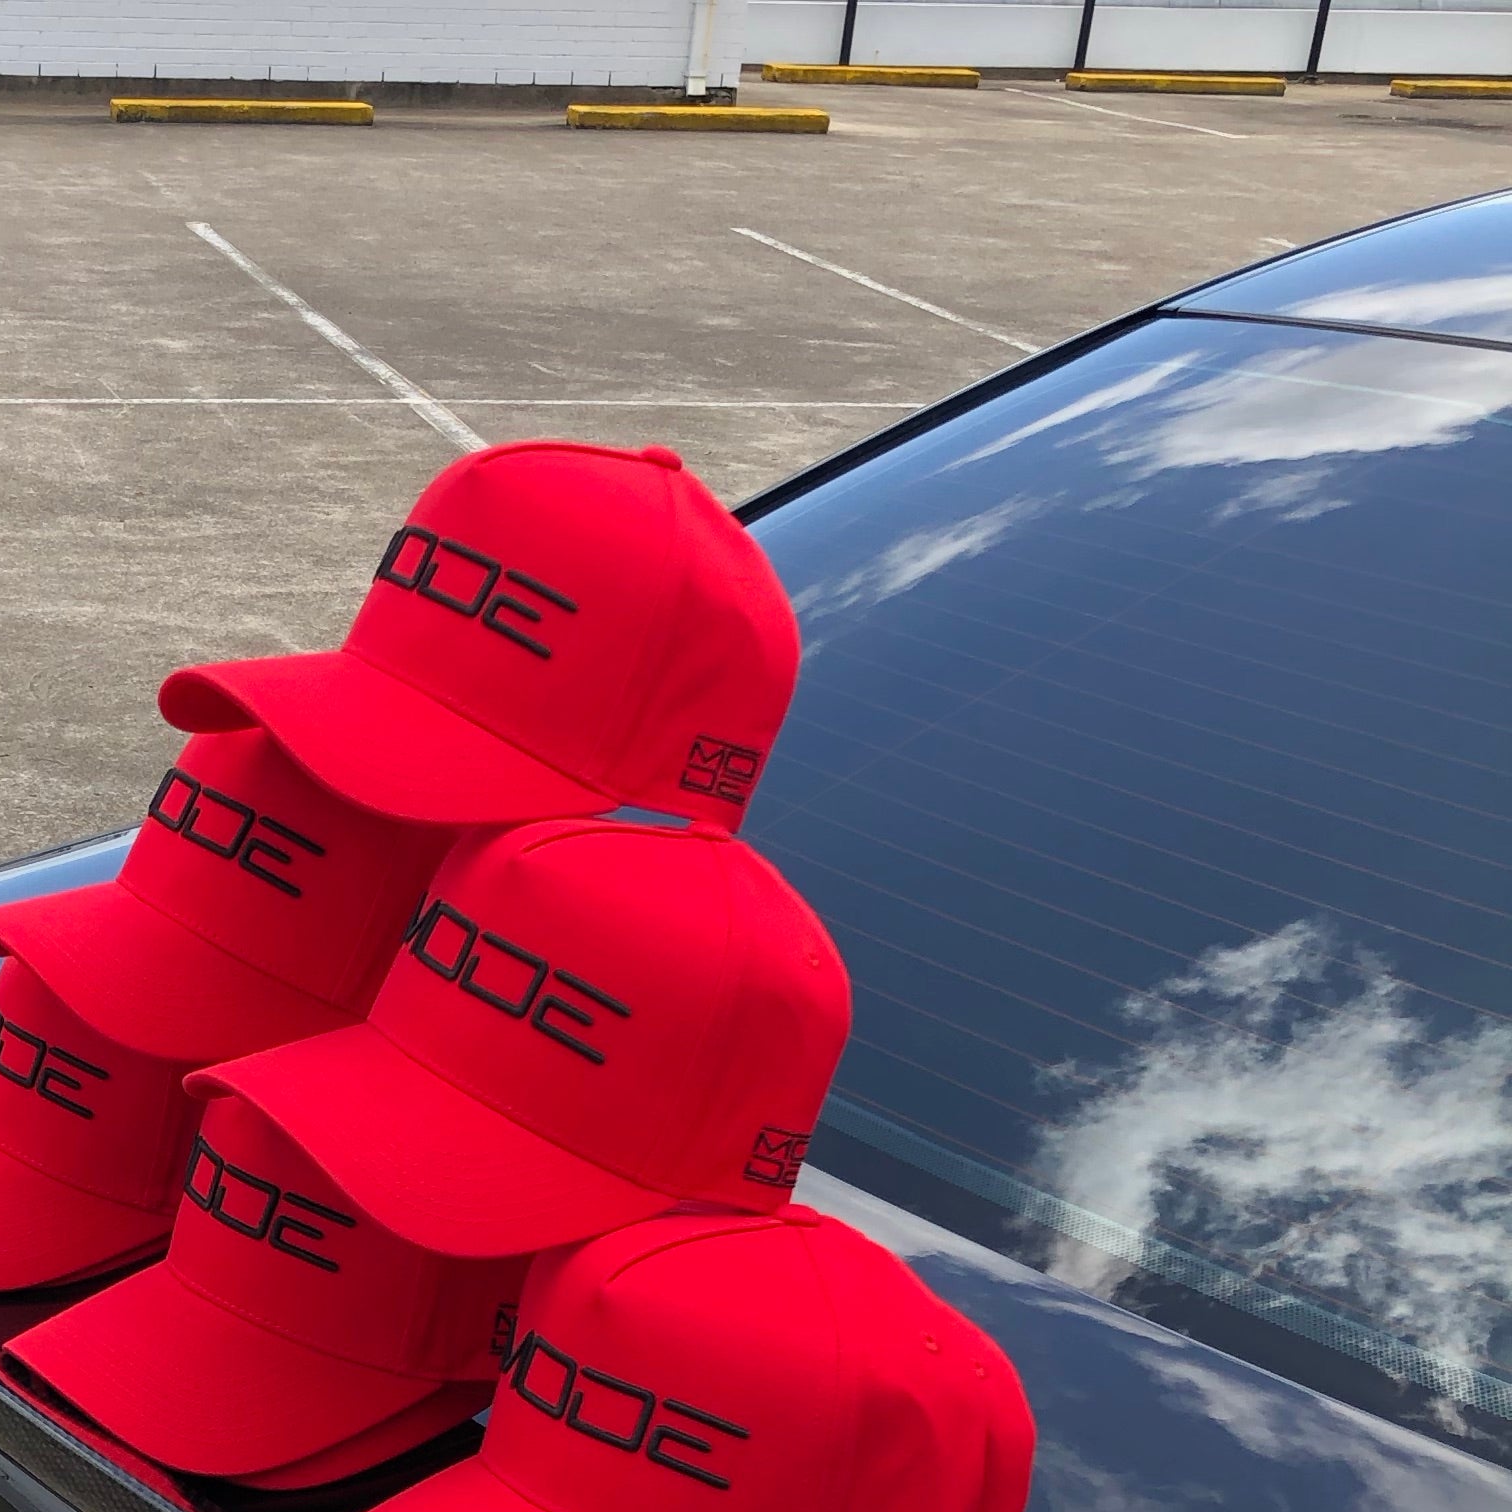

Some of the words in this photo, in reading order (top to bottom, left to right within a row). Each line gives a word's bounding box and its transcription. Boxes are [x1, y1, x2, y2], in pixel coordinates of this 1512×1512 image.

[372, 525, 578, 659] ODE
[148, 767, 325, 897] ODE
[184, 1131, 356, 1272] ODE
